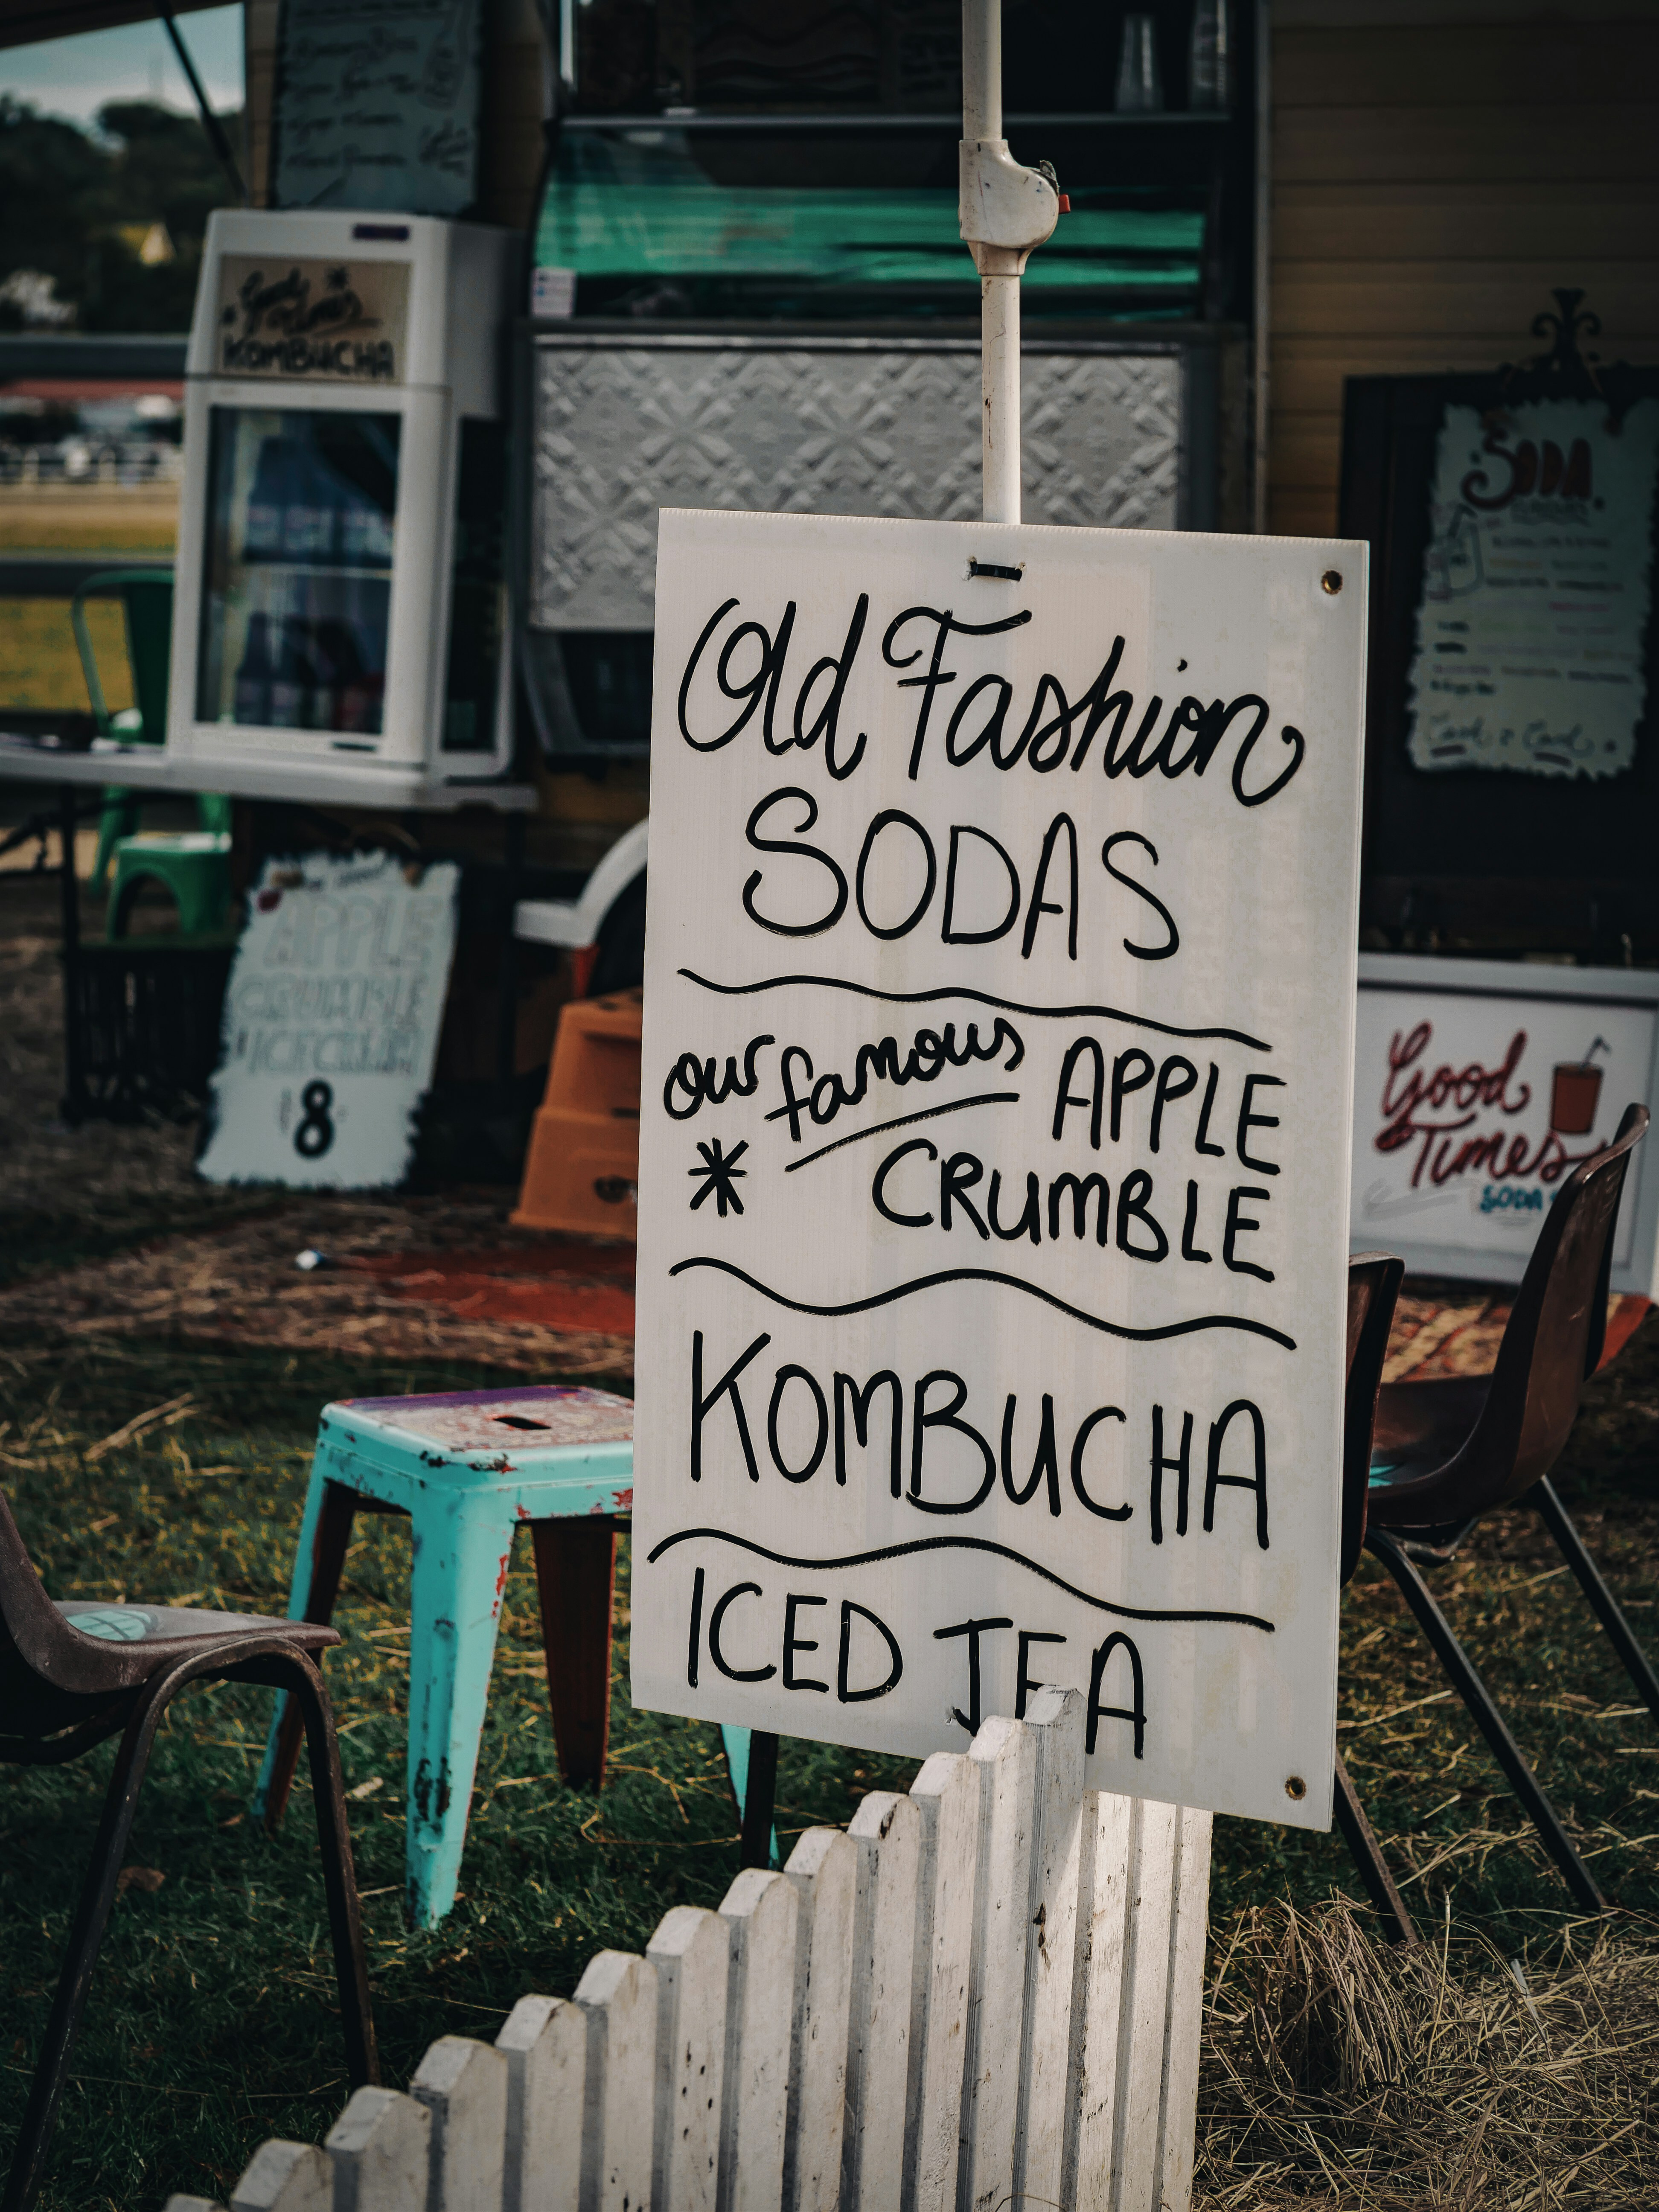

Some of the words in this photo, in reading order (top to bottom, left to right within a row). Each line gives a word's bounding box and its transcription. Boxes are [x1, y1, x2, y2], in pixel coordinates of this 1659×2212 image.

[1461, 430, 1593, 508] SODA
[678, 593, 869, 781] Old
[882, 607, 1305, 808] Fashion
[742, 786, 1179, 961] SODAS
[294, 1080, 336, 1160] 8
[663, 1034, 776, 1121] our
[764, 1017, 1025, 1142] famous
[1052, 1036, 1287, 1176] APPLE
[1375, 1019, 1531, 1150] Good
[1408, 1112, 1609, 1188] Times
[872, 1138, 1275, 1283] CRUMBLE
[1481, 1185, 1542, 1213] SODA
[690, 1330, 1270, 1551] KOMBUCHA
[688, 1567, 903, 1704] ICED
[932, 1617, 1147, 1760] TEA
